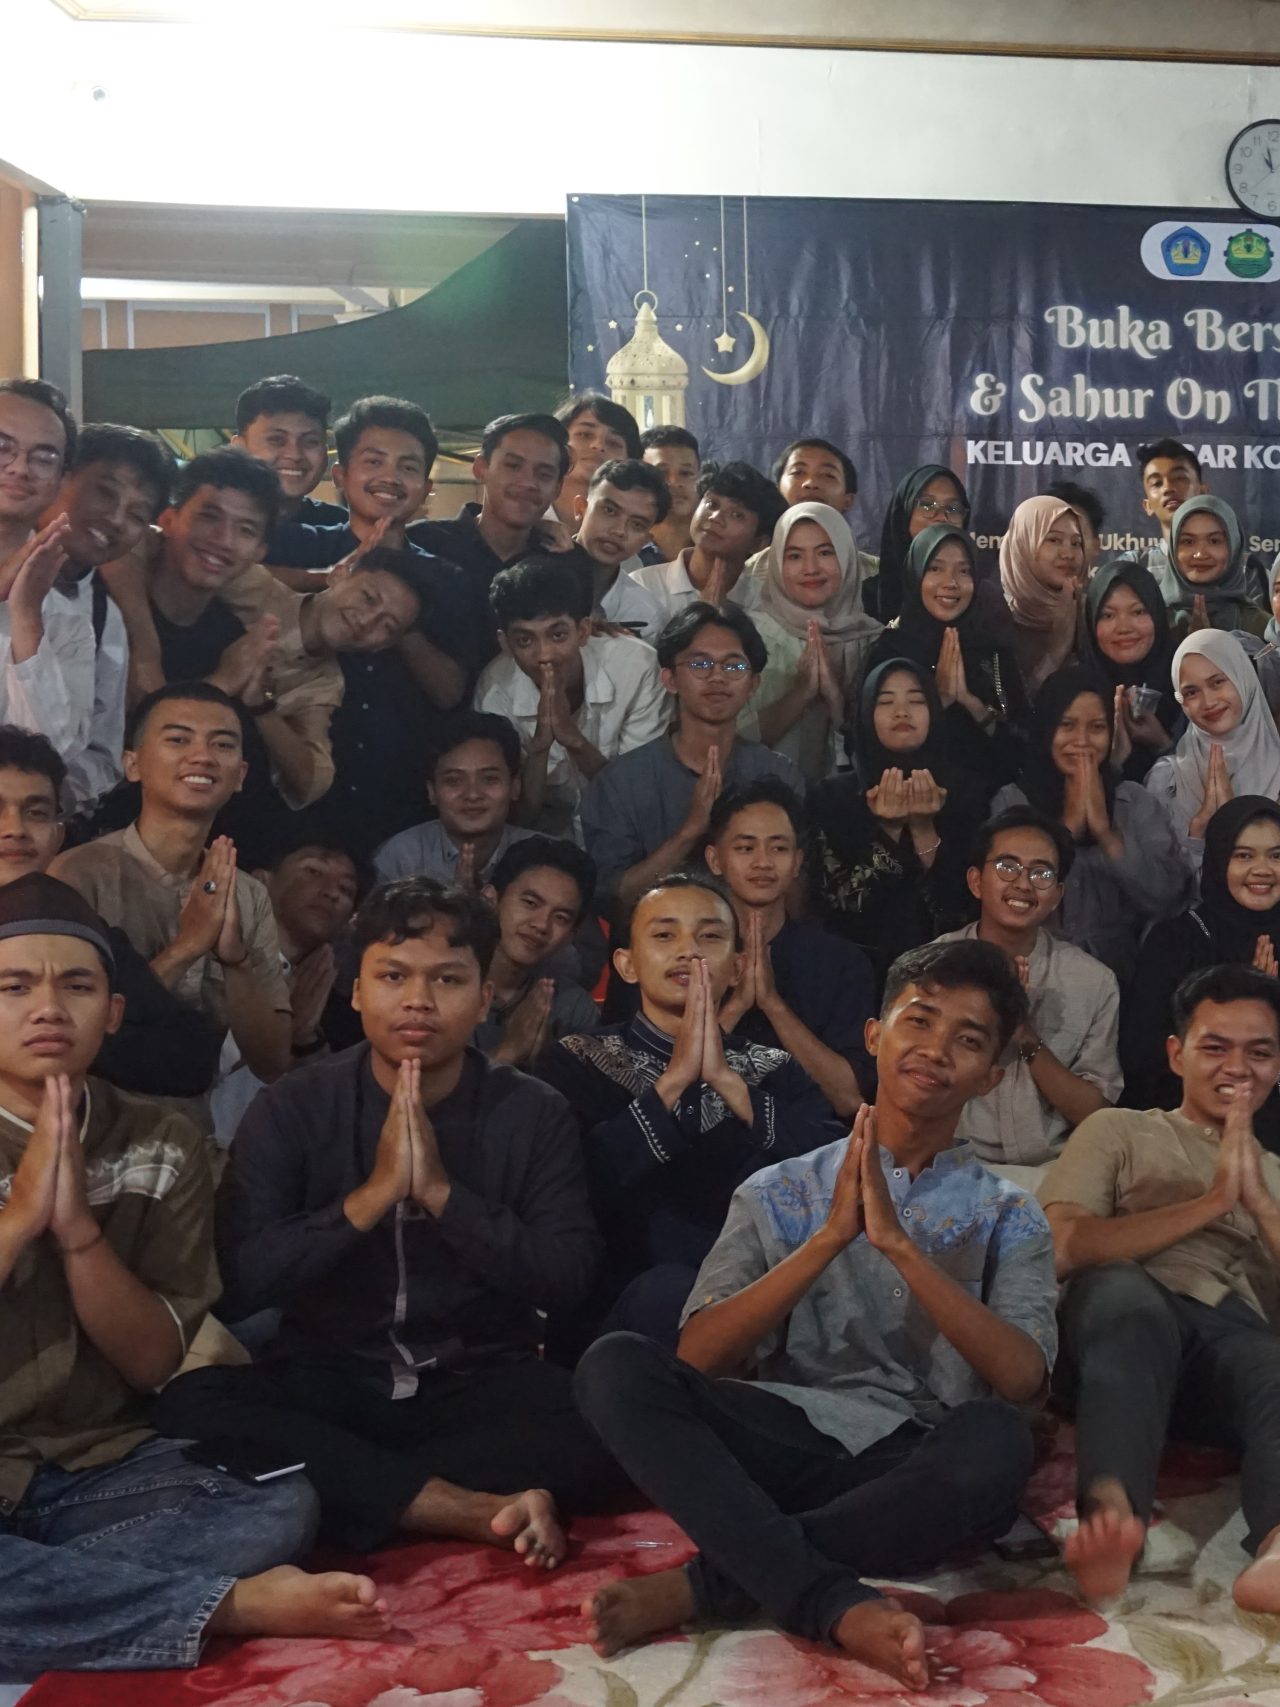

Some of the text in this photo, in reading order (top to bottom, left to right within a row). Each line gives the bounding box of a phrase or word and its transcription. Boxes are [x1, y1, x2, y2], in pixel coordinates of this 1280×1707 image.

[1044, 304, 1172, 358] Buka
[970, 372, 1007, 415] &
[1018, 373, 1154, 422] Sahur
[1166, 378, 1232, 424] On
[967, 440, 1132, 467] KELUARGA
